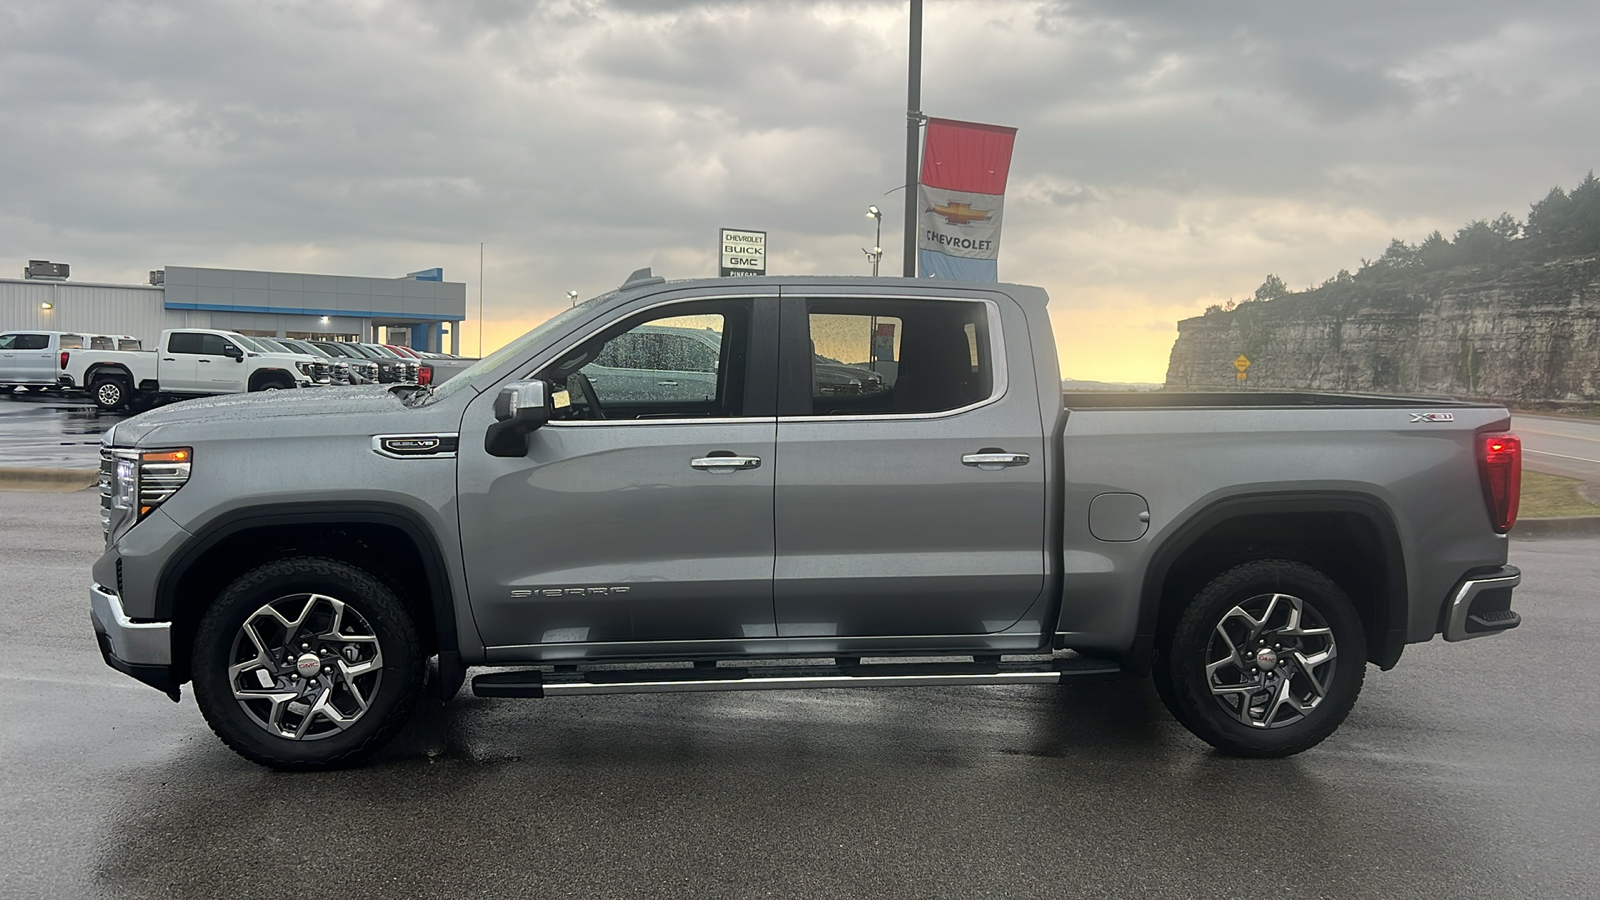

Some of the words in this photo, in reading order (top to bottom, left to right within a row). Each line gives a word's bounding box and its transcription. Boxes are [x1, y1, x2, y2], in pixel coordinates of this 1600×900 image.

[726, 234, 763, 243] CHEVROLET
[926, 230, 992, 250] CHEVROLET
[725, 246, 762, 255] BUICK
[730, 257, 758, 266] GMC
[510, 587, 630, 598] SIERRA
